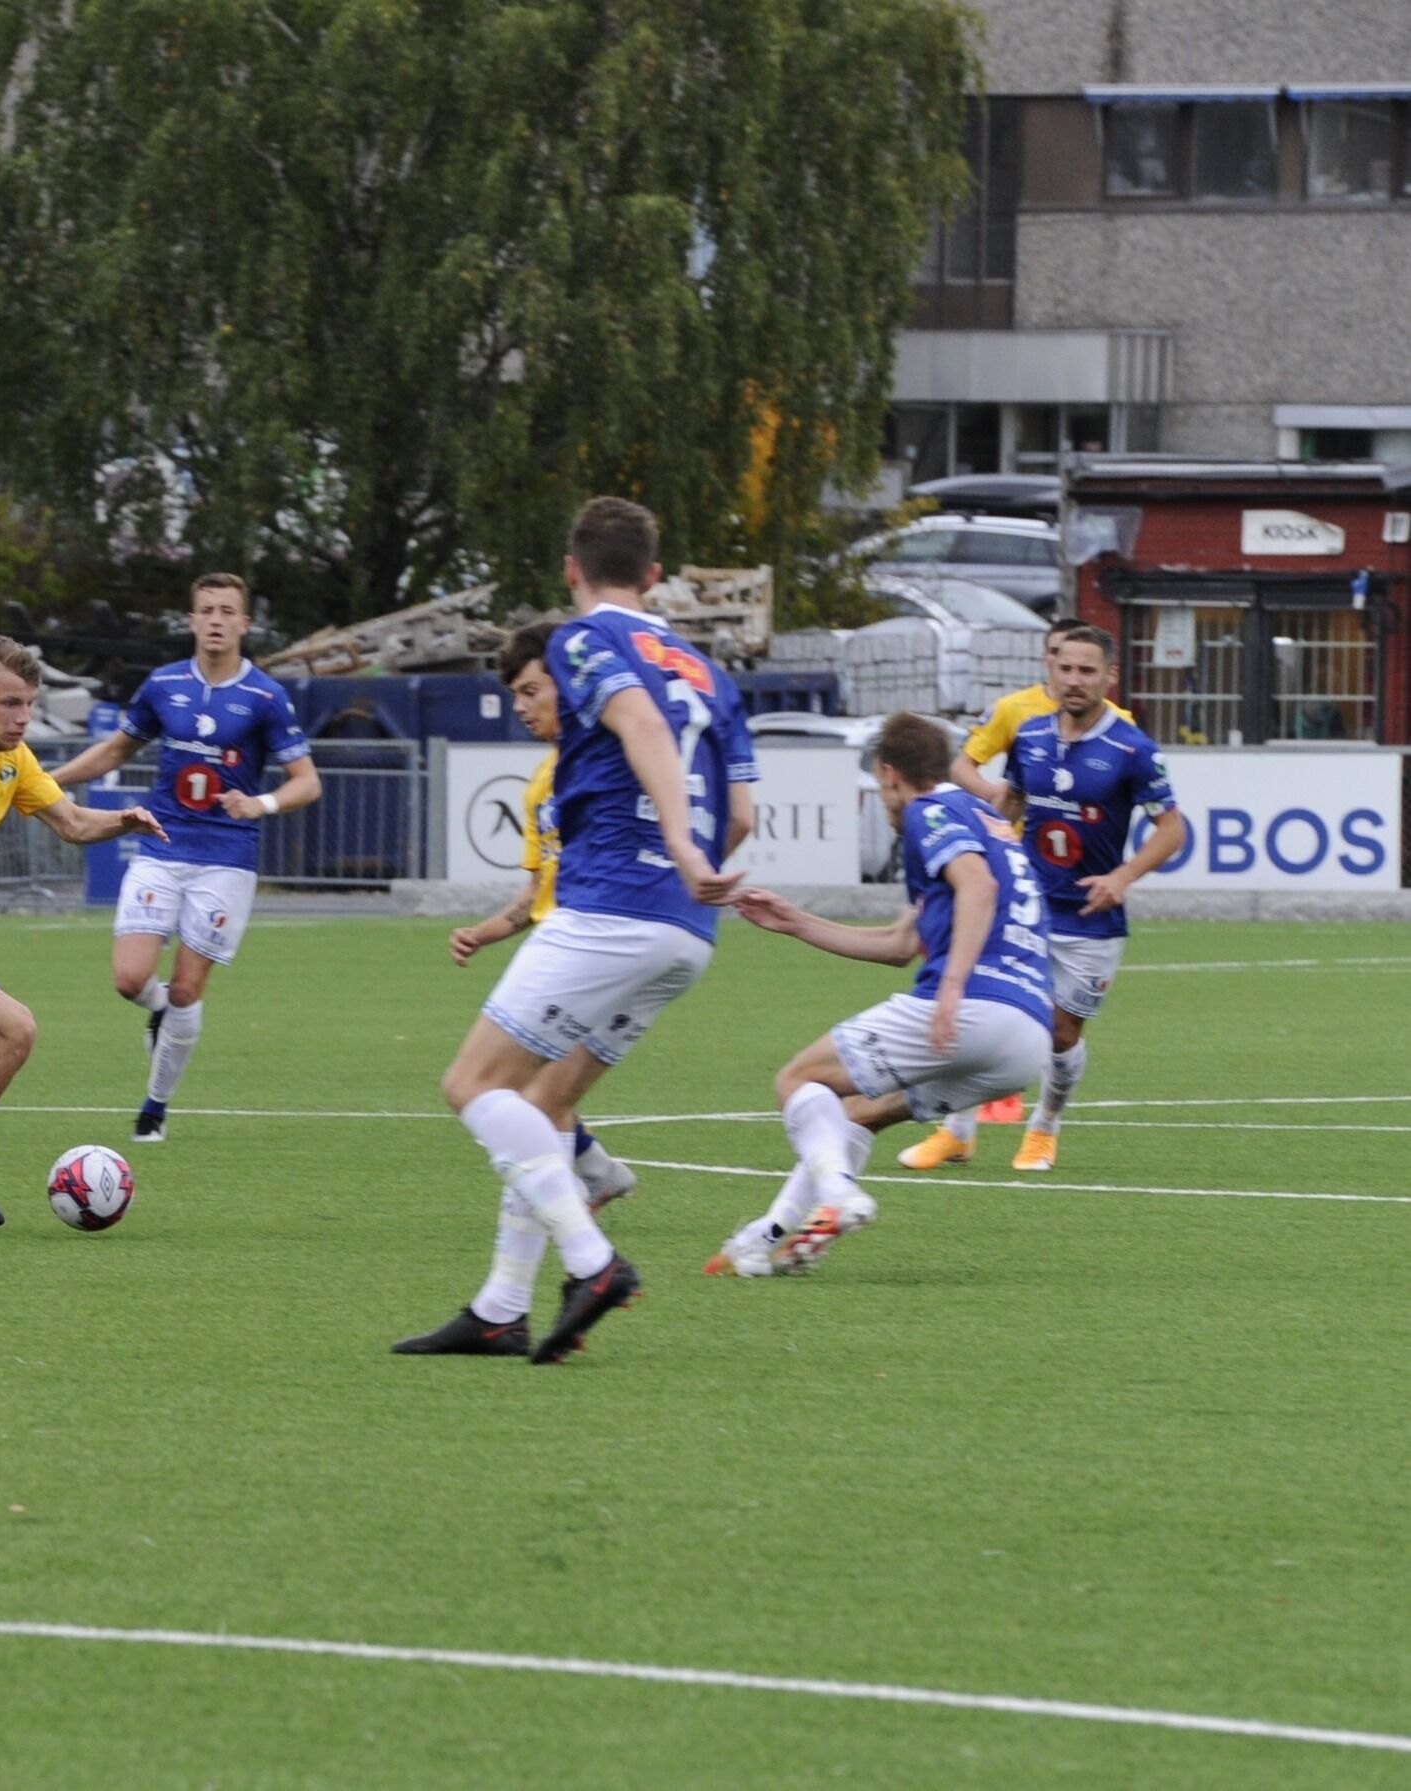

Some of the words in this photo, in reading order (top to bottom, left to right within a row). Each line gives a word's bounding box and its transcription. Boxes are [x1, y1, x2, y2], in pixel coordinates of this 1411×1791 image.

[186, 772, 207, 800] 1
[1046, 829, 1068, 857] 1
[1132, 808, 1386, 875] OBOS
